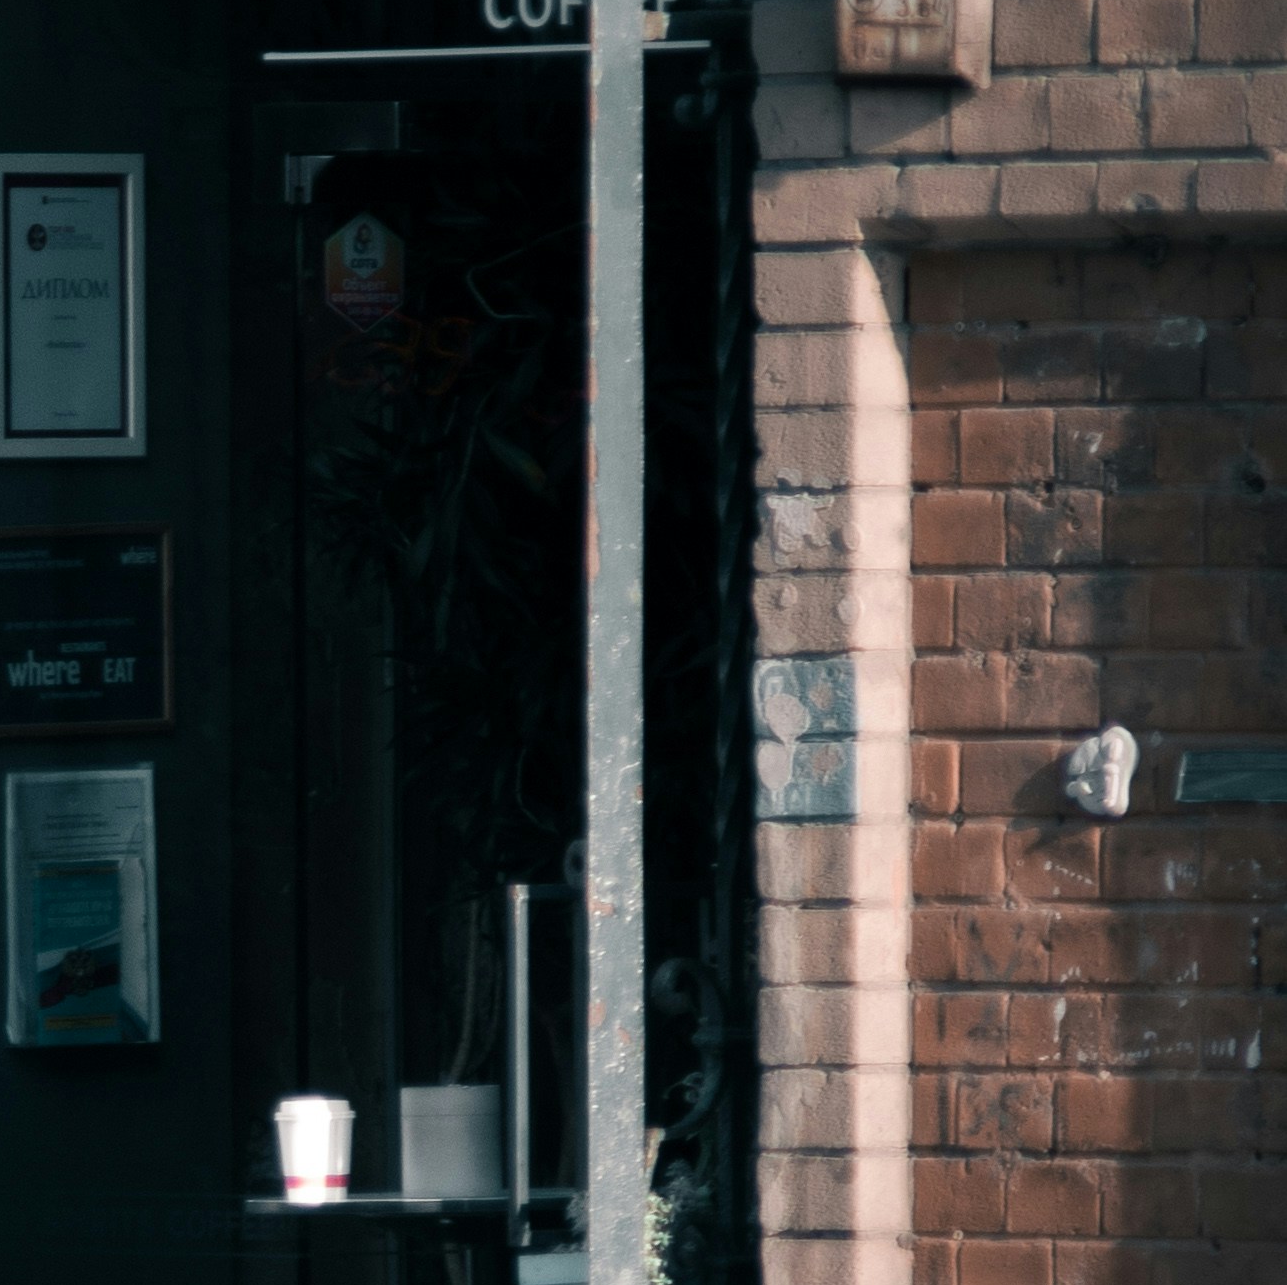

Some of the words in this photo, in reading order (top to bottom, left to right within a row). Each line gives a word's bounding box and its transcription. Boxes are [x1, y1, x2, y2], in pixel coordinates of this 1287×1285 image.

[22, 278, 110, 299] ДИПЛОМ
[7, 649, 81, 687] where
[103, 657, 136, 683] EAT
